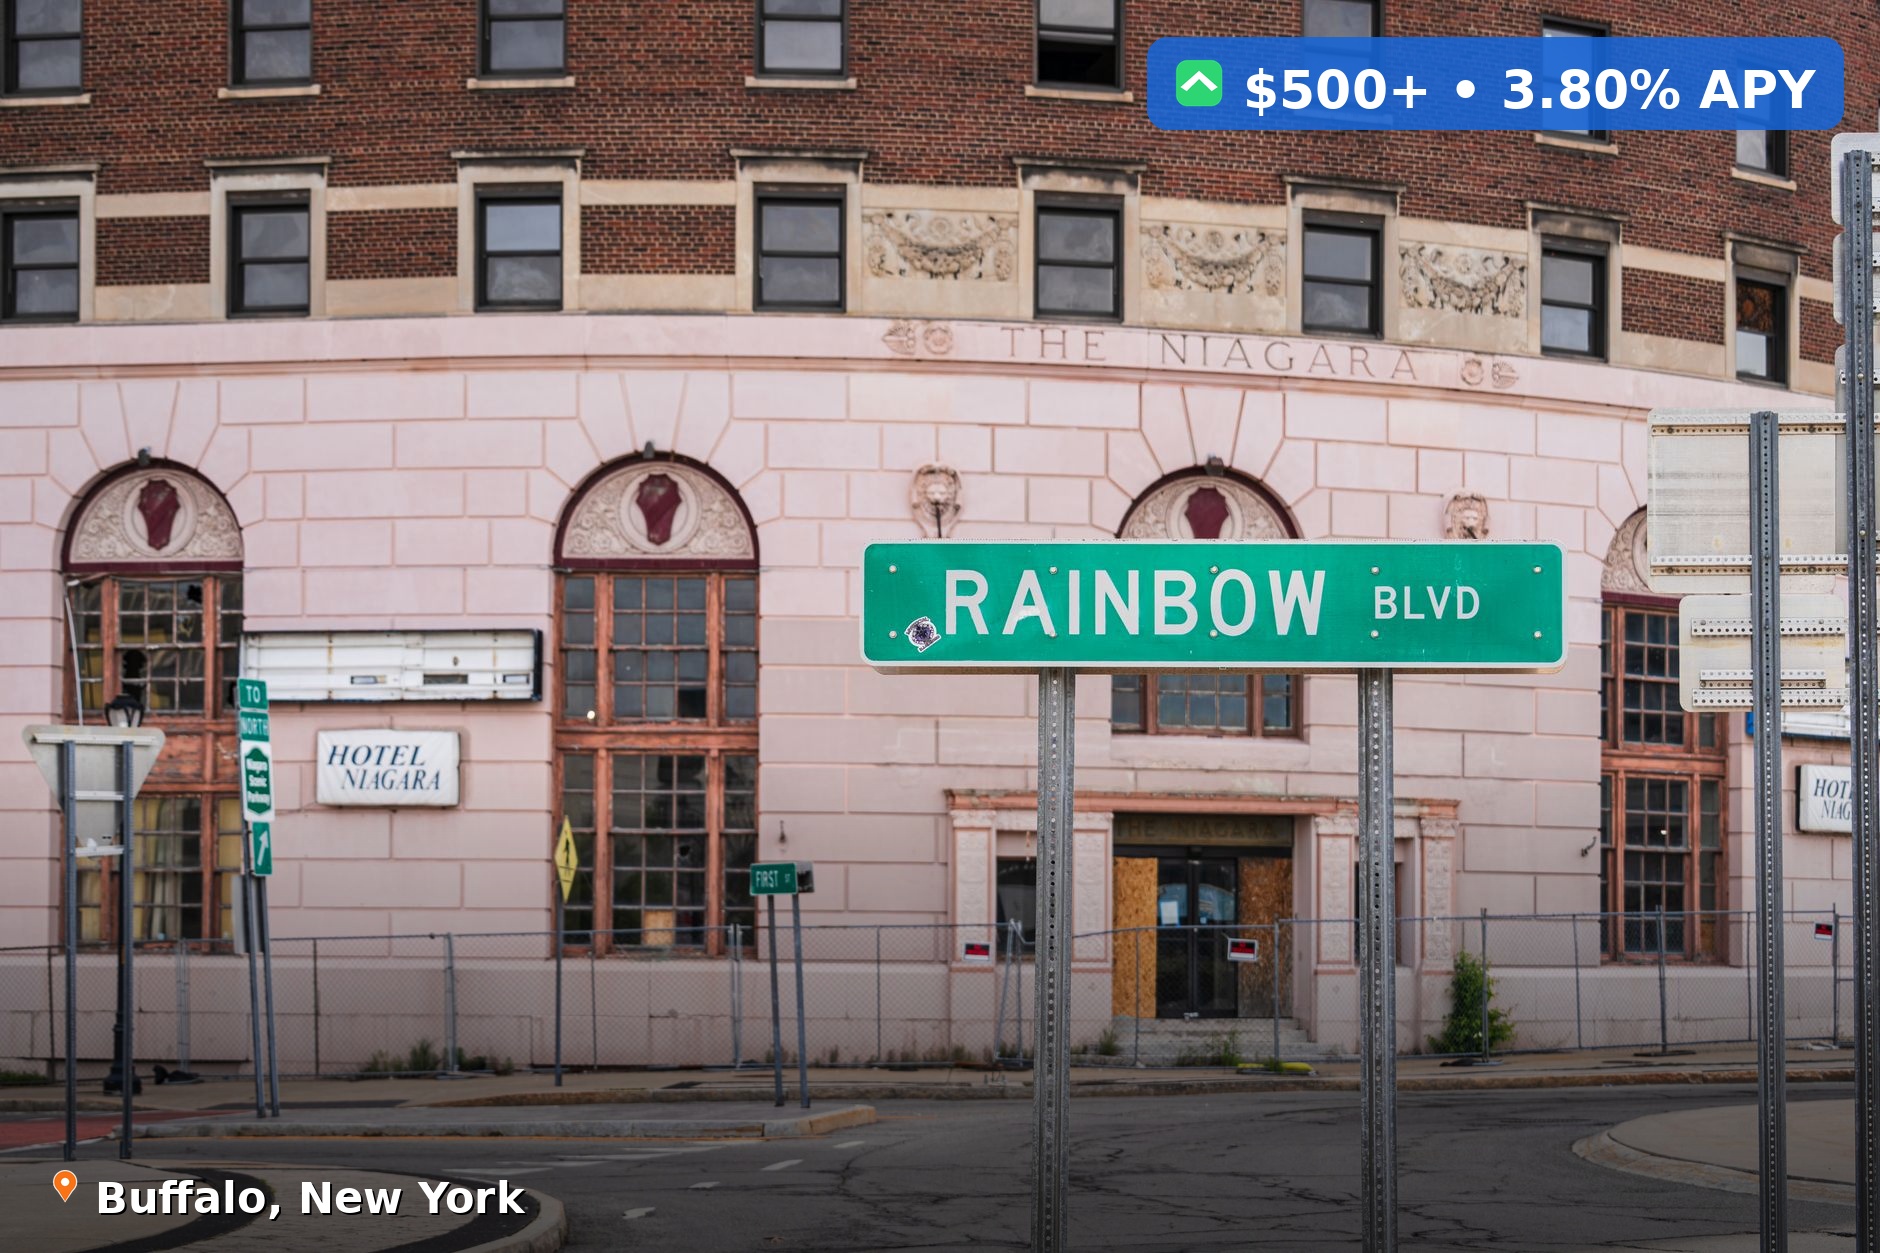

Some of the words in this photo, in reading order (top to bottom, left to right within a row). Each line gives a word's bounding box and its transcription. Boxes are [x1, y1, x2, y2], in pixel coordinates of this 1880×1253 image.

[1000, 326, 1106, 361] THE
[1160, 333, 1418, 381] NIAGARA
[945, 569, 1326, 637] RAINBOW
[1374, 586, 1480, 620] BLVD
[245, 684, 262, 704] TO
[240, 716, 269, 736] NORTH
[327, 744, 426, 767] HOTEL
[340, 768, 442, 791] NIAGARA
[1814, 778, 1854, 800] HOT
[1821, 799, 1852, 821] NIAG
[1171, 818, 1277, 839] NIAGARA
[755, 869, 779, 888] FIRST
